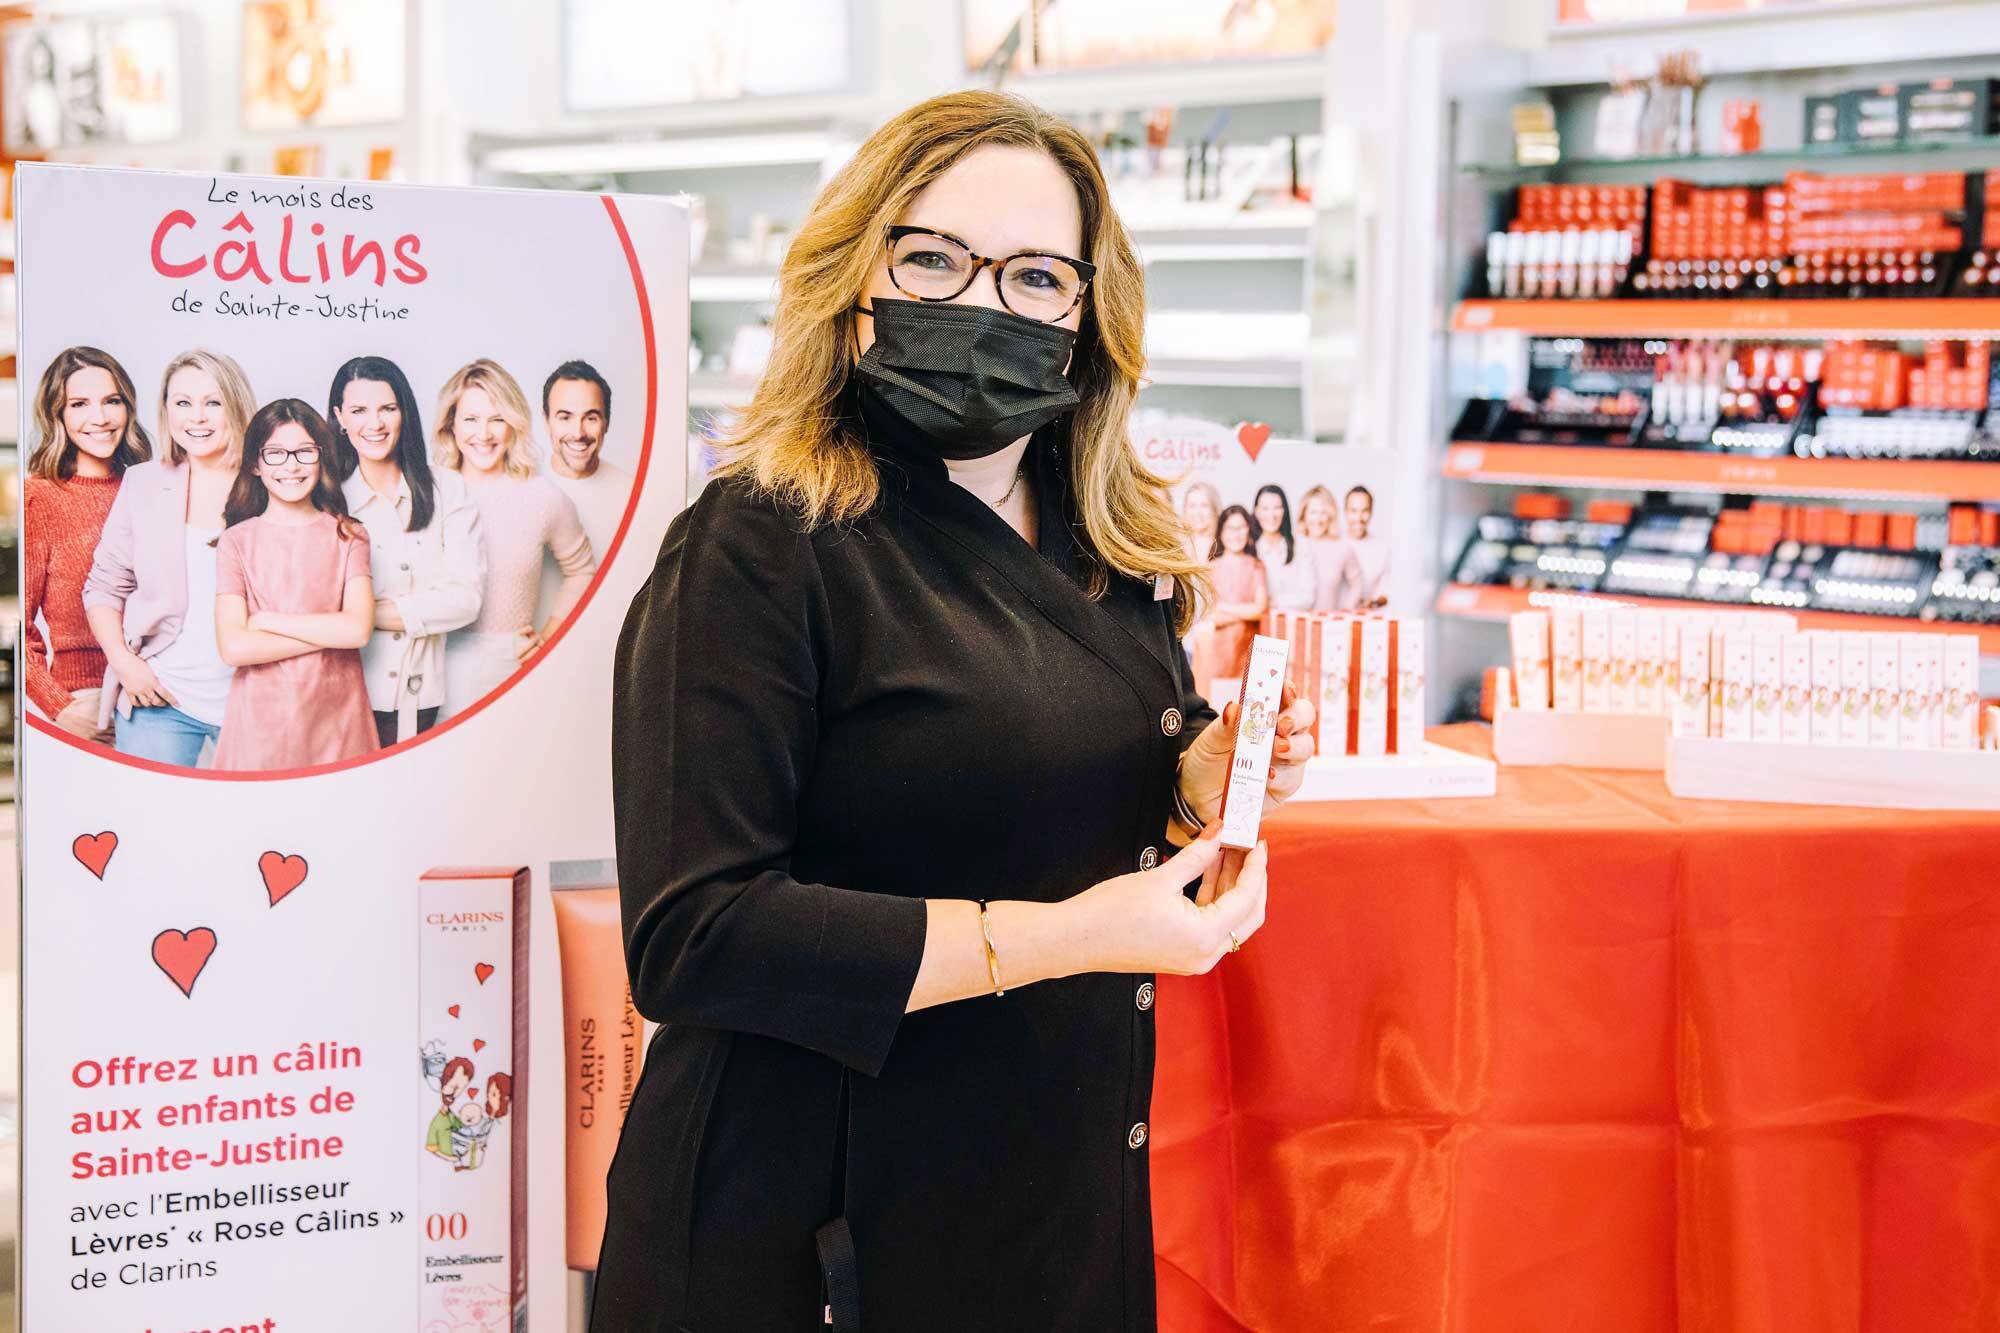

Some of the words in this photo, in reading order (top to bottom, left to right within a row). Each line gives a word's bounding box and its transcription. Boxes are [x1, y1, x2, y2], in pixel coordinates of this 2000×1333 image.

[207, 178, 239, 203] Le
[251, 185, 322, 208] mois
[330, 186, 373, 211] des
[151, 209, 428, 287] Câlins
[171, 289, 203, 314] de
[215, 291, 409, 322] Sainte-Justine
[426, 912, 504, 925] CLARINS
[72, 1056, 198, 1088] Offrez
[212, 1054, 258, 1078] un
[273, 1041, 362, 1073] câlin
[580, 1018, 596, 1129] CLARINS
[71, 1107, 143, 1135] aux
[157, 1092, 297, 1127] enfants
[309, 1086, 355, 1114] de
[71, 1133, 345, 1180] Sainte-Justine
[70, 1201, 139, 1223] avec
[214, 1221, 285, 1242] Rose
[295, 1209, 380, 1234] Câlins
[426, 1212, 467, 1241] 00
[71, 1267, 107, 1290] de
[119, 1258, 217, 1285] Clarins
